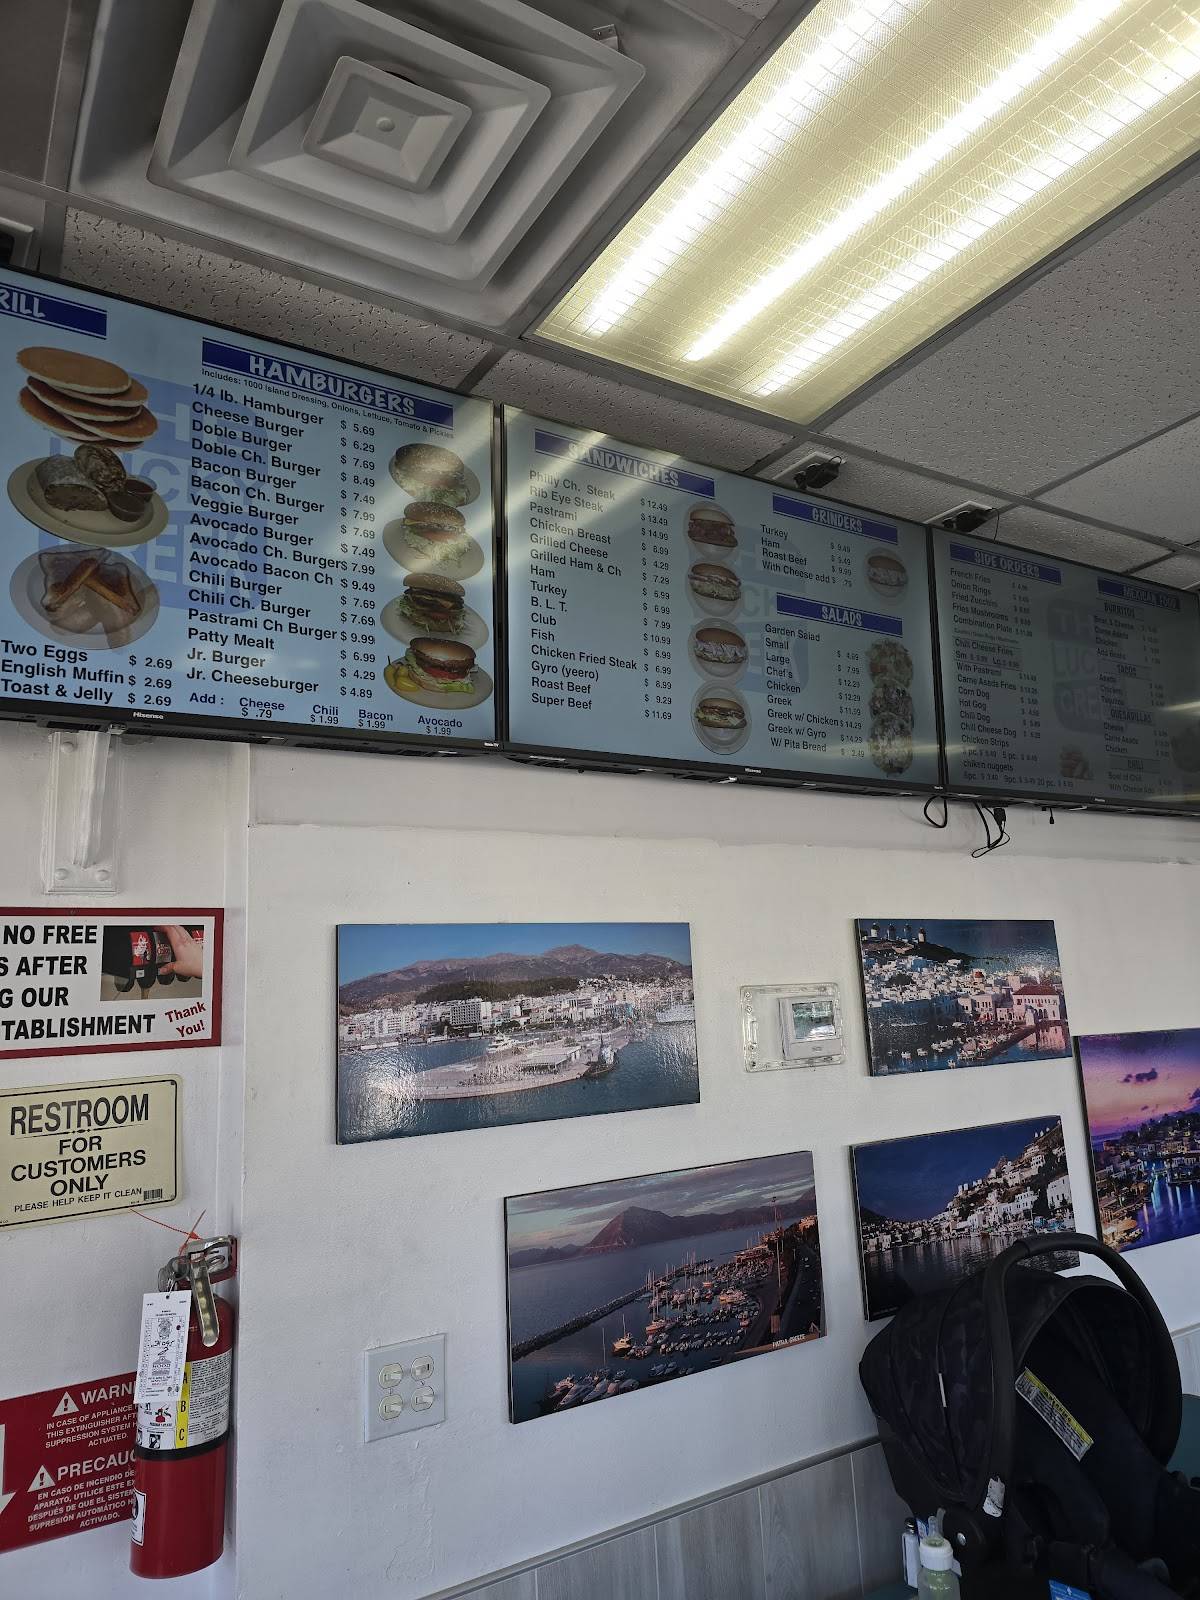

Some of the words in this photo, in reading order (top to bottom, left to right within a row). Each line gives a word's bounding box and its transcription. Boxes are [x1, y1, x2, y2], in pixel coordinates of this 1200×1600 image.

[201, 368, 241, 385] Includes:
[243, 379, 263, 391] 1000
[249, 355, 415, 416] HAMBURGERS
[192, 383, 215, 398] 1/4
[220, 389, 238, 404] lb.
[243, 394, 324, 425] Hamburger
[192, 401, 249, 425] Cheese
[254, 415, 304, 437] Burger
[192, 418, 237, 440] Doble
[241, 430, 292, 453] Burger
[191, 437, 237, 458] Doble
[241, 449, 266, 464] Ch.
[271, 455, 321, 477] Burger
[568, 443, 679, 487] SANDWICHES
[191, 455, 241, 478] Bacon
[246, 467, 296, 489] Burger
[191, 474, 240, 496] Bacon
[245, 486, 270, 502] Ch.
[275, 492, 325, 513] Burger
[190, 493, 243, 515] Veggie
[248, 504, 299, 525] Burger
[529, 501, 577, 520] Pastrami
[811, 507, 863, 532] GRINDERS
[190, 513, 258, 536] Avocado
[263, 526, 314, 546] Burger
[529, 517, 574, 536] Chicken
[577, 527, 611, 545] Breast
[189, 531, 258, 554] Avocado
[262, 544, 287, 560] Ch.
[292, 549, 340, 569] Burger
[530, 532, 566, 550] Grilled
[569, 541, 608, 559] Cheese
[189, 550, 257, 573] Avocado
[263, 562, 309, 581] Bacon
[314, 571, 333, 585] Ch
[530, 548, 566, 565] Grilled
[569, 556, 593, 571] Ham
[596, 562, 604, 574] &
[607, 565, 621, 576] Ch
[530, 563, 555, 579] Ham
[189, 569, 225, 586] Chili
[230, 575, 282, 596] Burger
[529, 579, 567, 599] Turkey
[188, 588, 224, 605] Chili
[229, 595, 255, 610] Ch.
[260, 599, 311, 618] Burger
[188, 607, 258, 629] Pastrami
[262, 618, 283, 632] Ch
[288, 621, 338, 640] Burger
[530, 612, 556, 626] Club
[821, 605, 862, 626] SALADS
[188, 627, 228, 647] Patty
[234, 633, 274, 650] Mealt
[531, 628, 555, 642] Fish
[764, 623, 795, 637] Garden
[796, 629, 820, 642] Salad
[765, 637, 789, 650] Small
[0, 639, 37, 656] Two
[43, 644, 88, 663] Eggs
[187, 647, 206, 661] Jr.
[212, 649, 265, 669] Burger
[531, 644, 575, 661] Chicken
[578, 651, 606, 665] Fried
[608, 656, 637, 670] Steak
[765, 651, 790, 666] Large
[1, 658, 66, 679] English
[72, 666, 124, 684] Muffin
[186, 666, 205, 680] Jr.
[211, 669, 319, 693] Cheeseburger
[531, 660, 558, 675] Gyro
[561, 664, 599, 682] (yeero)
[766, 665, 793, 679] Chef's
[0, 678, 50, 696] Toast
[55, 683, 68, 697] &
[73, 685, 113, 704] Jelly
[531, 676, 564, 691] Roast
[567, 681, 591, 694] Beef
[766, 679, 801, 693] Chicken
[189, 692, 216, 704] Add
[239, 696, 285, 711] Cheese
[531, 692, 565, 707] Super
[567, 697, 592, 710] Beef
[767, 694, 792, 706] Greek
[312, 704, 338, 716] Chili
[358, 708, 393, 721] Bacon
[417, 715, 462, 728] Avocado
[767, 708, 793, 721] Greek
[794, 712, 805, 722] w/
[806, 713, 839, 726] Chicken
[3, 925, 35, 944] NO
[43, 925, 97, 944] FREE
[16, 956, 88, 976] AFTER
[21, 987, 69, 1007] OUR
[164, 1002, 207, 1023] Thank
[2, 1014, 156, 1040] TABLISHMENT
[176, 1020, 206, 1037] You!
[10, 1094, 149, 1135] RESTROOM
[59, 1135, 102, 1155] FOR
[11, 1150, 147, 1182] CUSTOMERS
[50, 1174, 109, 1197] ONLY
[14, 1201, 49, 1213] PLEASE
[52, 1197, 75, 1207] HELP
[77, 1193, 101, 1203] KEEP
[103, 1191, 112, 1200] IT
[114, 1187, 143, 1198] CLEAN
[46, 1422, 54, 1430] IN
[56, 1417, 77, 1428] CASE
[79, 1414, 89, 1423] OF
[91, 1404, 132, 1420] APPLIANCE
[180, 1400, 186, 1413] B
[45, 1430, 100, 1449] SUPPRESSION
[101, 1422, 131, 1435] SYSTEM
[46, 1429, 64, 1439] THIS
[65, 1415, 121, 1435] EXTINGUISHER
[178, 1428, 185, 1441] C
[88, 1432, 129, 1447] ACTUATED.
[33, 1496, 72, 1511] APARATO,
[73, 1487, 104, 1500] UTILICE
[105, 1482, 125, 1492] ESTE
[38, 1492, 49, 1501] EN
[50, 1487, 72, 1497] CASO
[73, 1482, 85, 1491] DE
[86, 1472, 123, 1488] INCENDIO
[27, 1507, 64, 1522] DESPUÉS
[66, 1504, 76, 1512] DE
[78, 1498, 96, 1509] QUE
[96, 1496, 105, 1504] EL
[80, 1512, 120, 1528] ACTIVADO.
